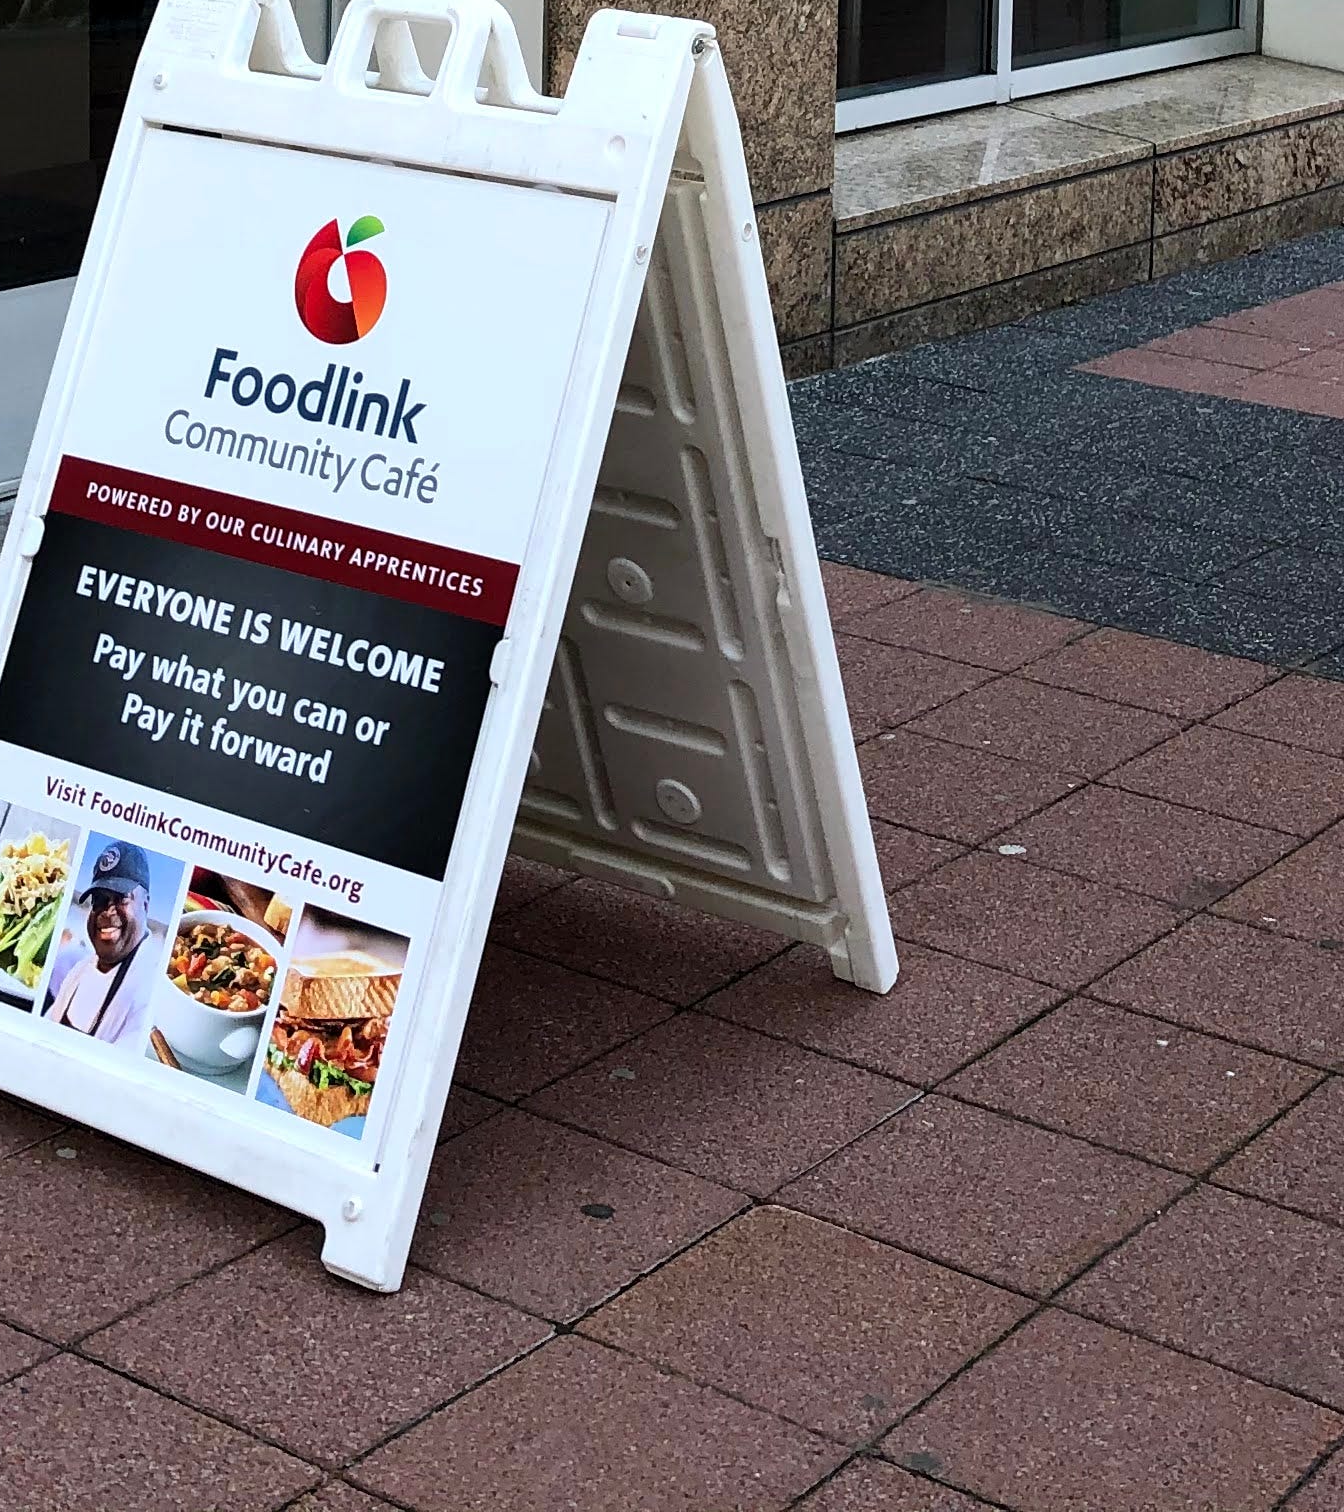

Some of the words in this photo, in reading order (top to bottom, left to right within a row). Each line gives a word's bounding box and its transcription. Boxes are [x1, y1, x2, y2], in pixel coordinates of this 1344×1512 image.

[204, 348, 427, 444] Foodlink
[165, 409, 356, 493] Community
[360, 453, 439, 504] Café
[86, 481, 172, 518] POWERED
[178, 503, 202, 525] BY
[205, 511, 245, 537] OUR
[251, 522, 345, 561] CULINARY
[349, 548, 483, 597] APPRENTICES
[76, 566, 233, 635] EVERYONE
[240, 608, 271, 645] IS
[280, 618, 445, 694] WELCOME
[93, 633, 145, 679] Pay
[152, 650, 226, 696] what
[227, 676, 286, 717] you
[293, 698, 347, 736] can
[355, 714, 390, 747] or
[121, 693, 174, 741] Pay
[179, 708, 204, 746] it
[209, 717, 332, 784] forward
[46, 775, 87, 808] Visit
[90, 791, 364, 904] FoodlinkCommunityCafe.org
